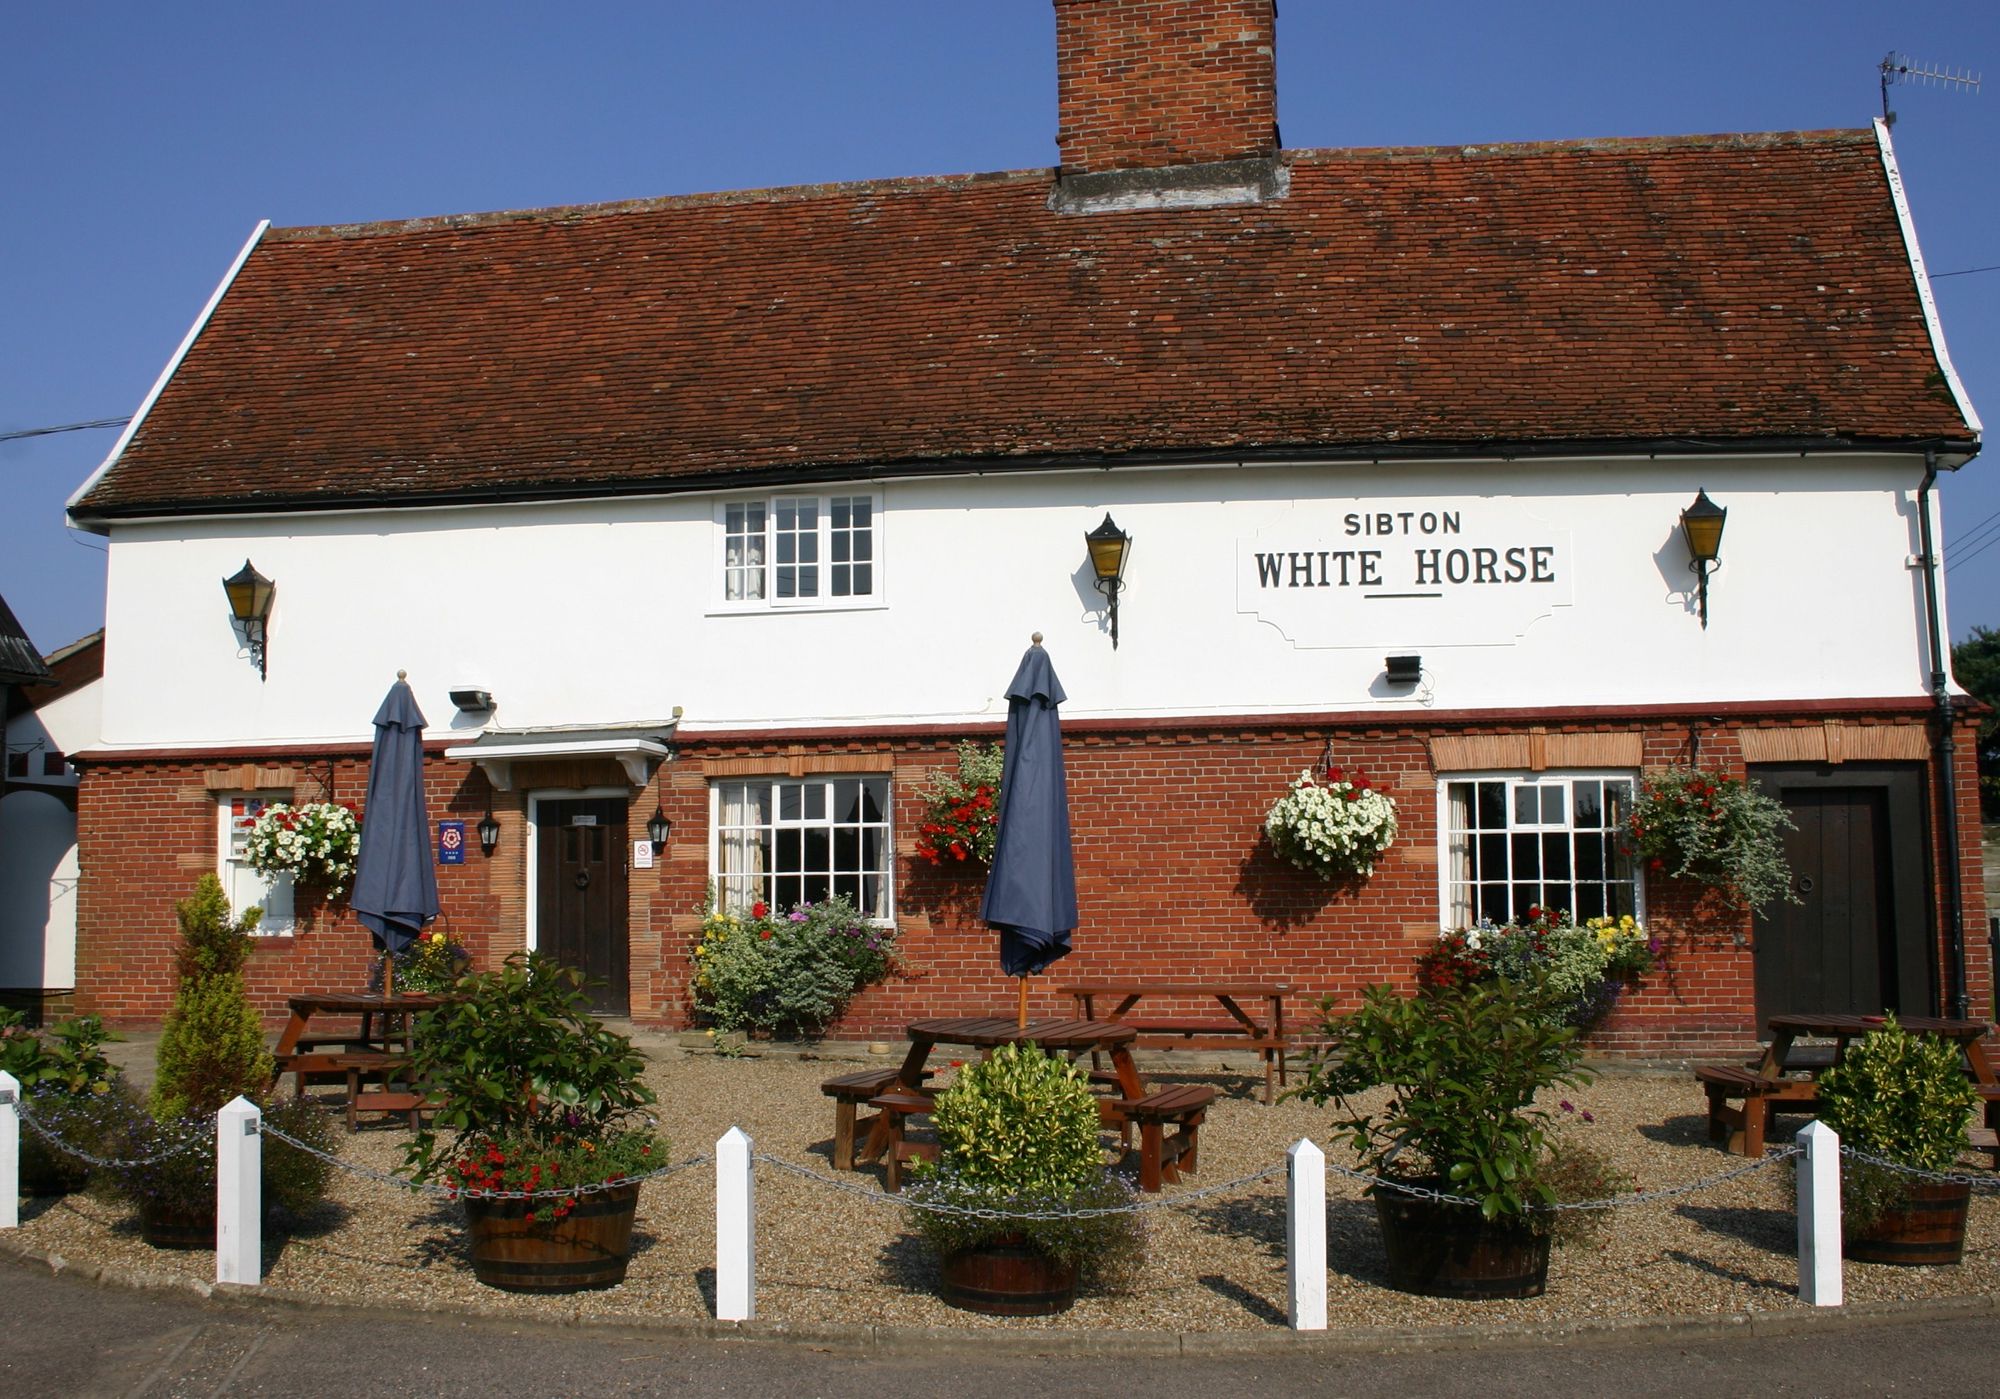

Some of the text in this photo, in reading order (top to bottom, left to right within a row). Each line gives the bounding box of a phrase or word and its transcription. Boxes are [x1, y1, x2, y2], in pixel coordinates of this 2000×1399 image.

[1344, 511, 1460, 536] SIBTON
[1254, 546, 1555, 588] WHITE HORSE
